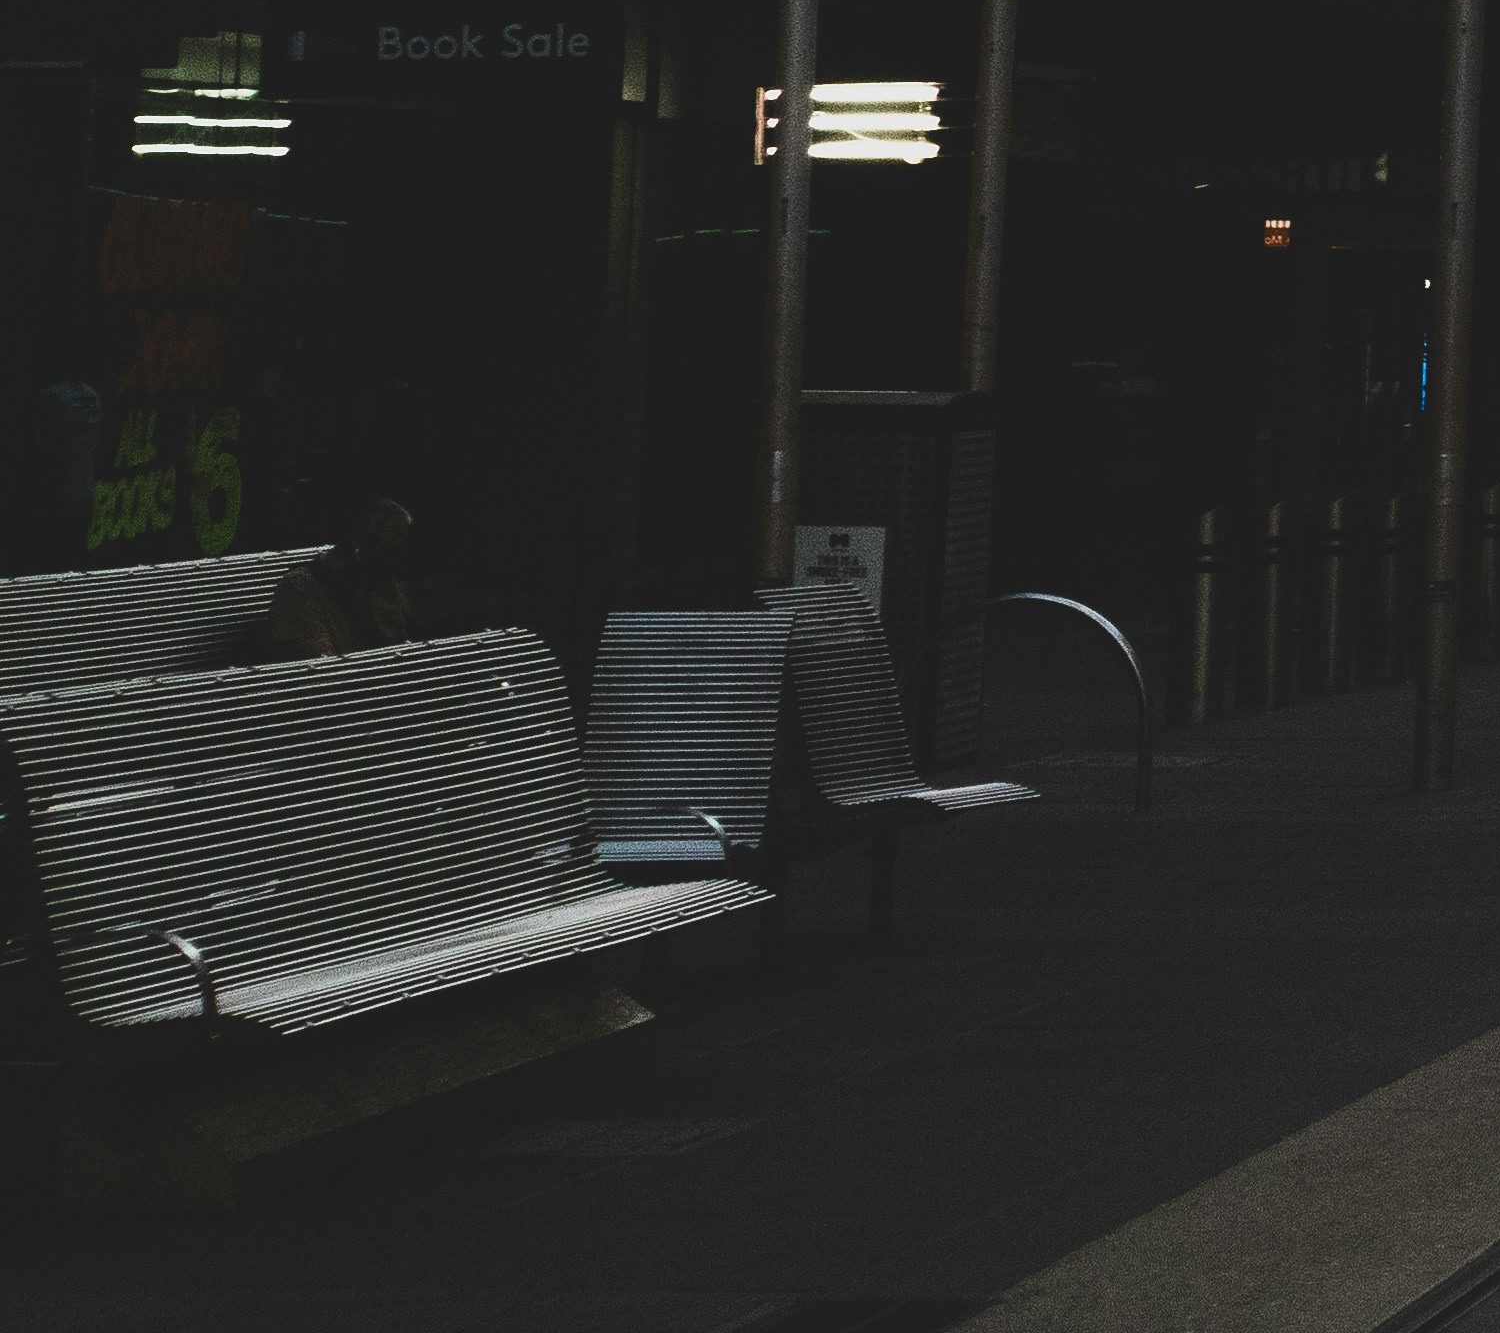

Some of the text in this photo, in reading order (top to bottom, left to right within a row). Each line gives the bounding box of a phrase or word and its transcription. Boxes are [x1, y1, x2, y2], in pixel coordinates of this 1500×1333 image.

[377, 25, 486, 61] Book
[501, 23, 591, 60] Sale
[85, 465, 177, 551] BOOKS
